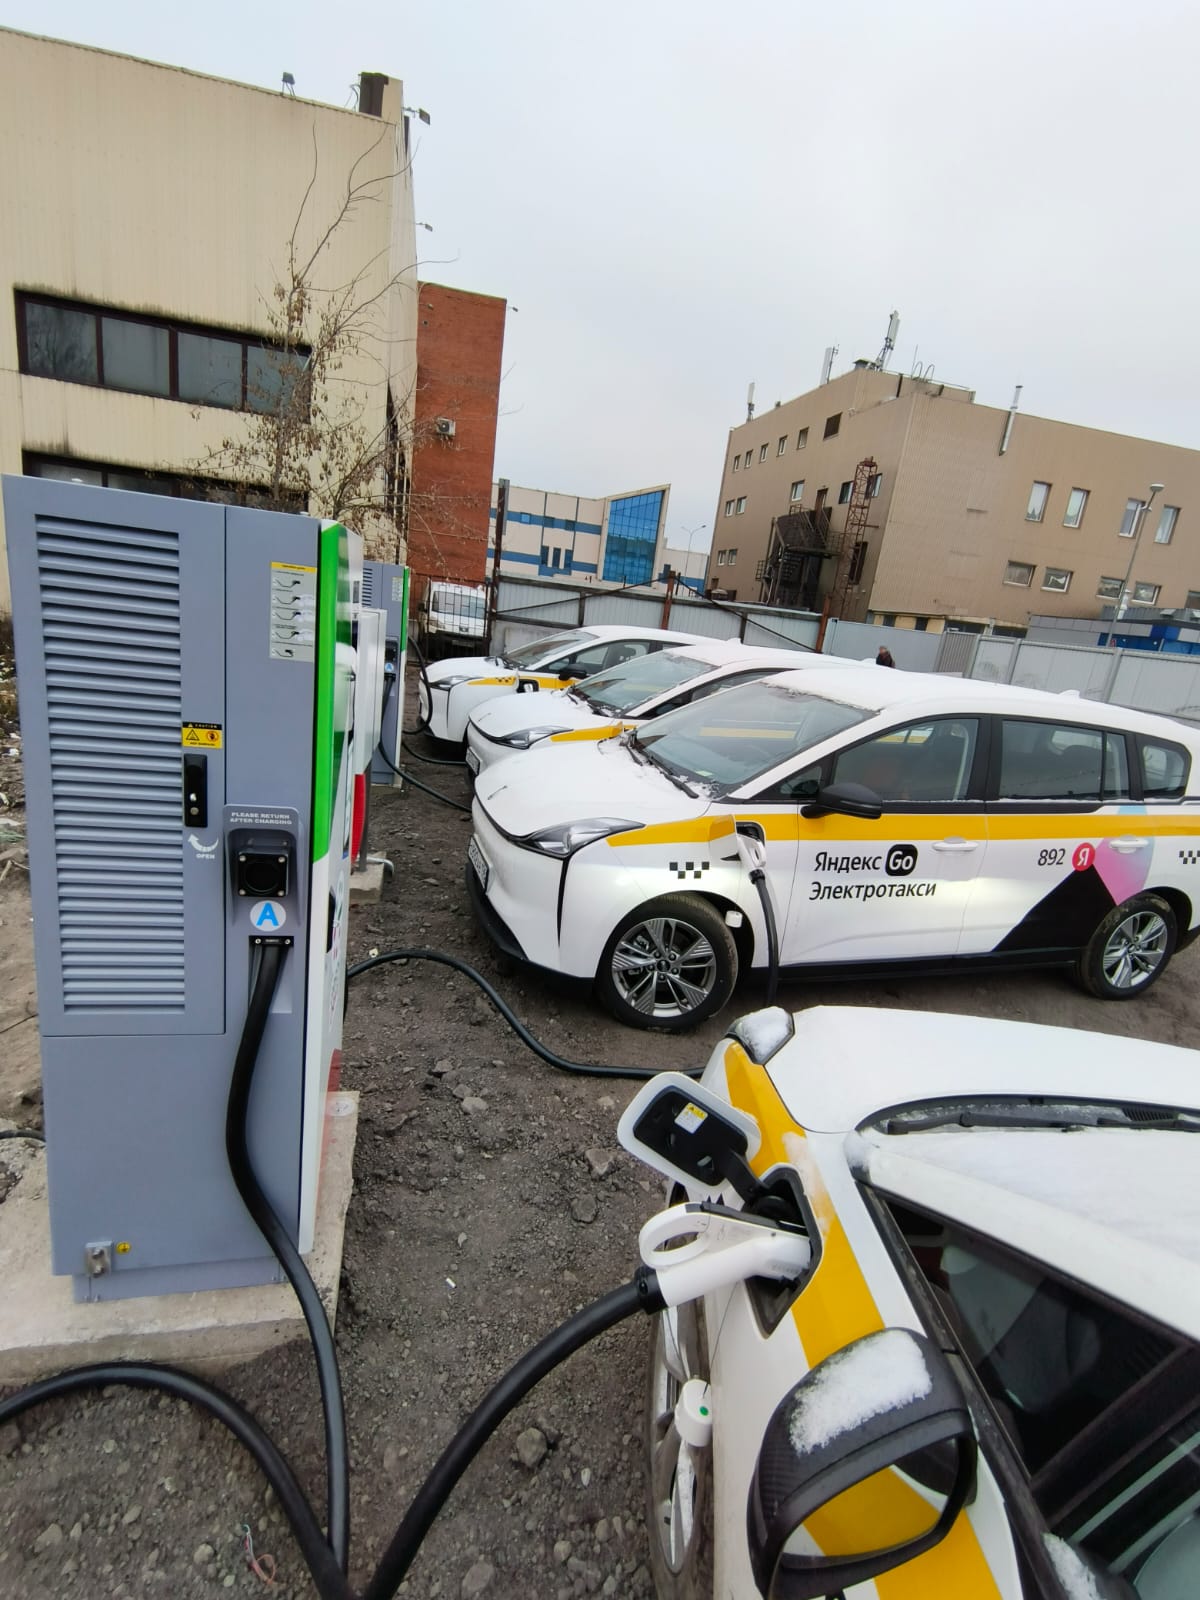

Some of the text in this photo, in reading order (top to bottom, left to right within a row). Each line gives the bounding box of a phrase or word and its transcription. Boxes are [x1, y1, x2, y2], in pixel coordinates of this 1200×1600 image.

[814, 850, 914, 873] Яндекс Go
[1037, 848, 1066, 866] 892
[1077, 847, 1090, 866] Я
[809, 881, 937, 902] Электротакси
[256, 902, 279, 926] A
